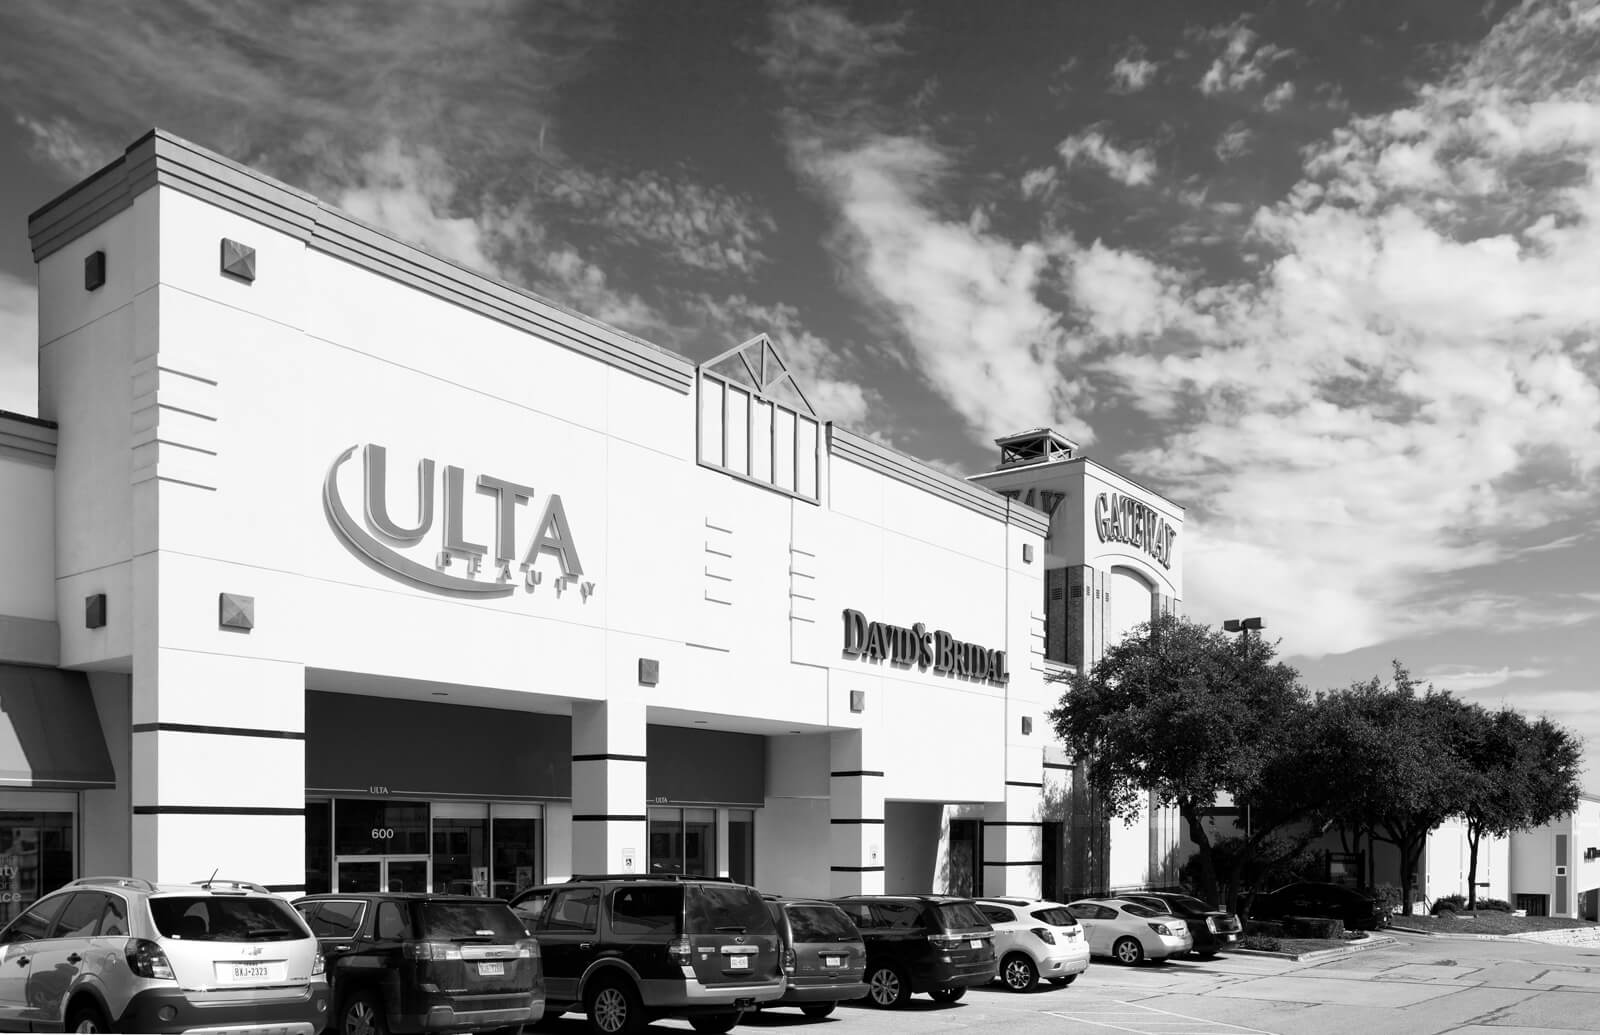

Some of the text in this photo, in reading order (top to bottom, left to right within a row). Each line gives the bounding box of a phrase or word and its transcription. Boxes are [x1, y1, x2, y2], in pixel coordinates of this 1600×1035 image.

[363, 442, 585, 580] ULTA
[1095, 491, 1177, 571] GATEWAY
[436, 551, 596, 603] BEAUTY
[370, 785, 389, 794] ULTA
[371, 828, 394, 839] 600
